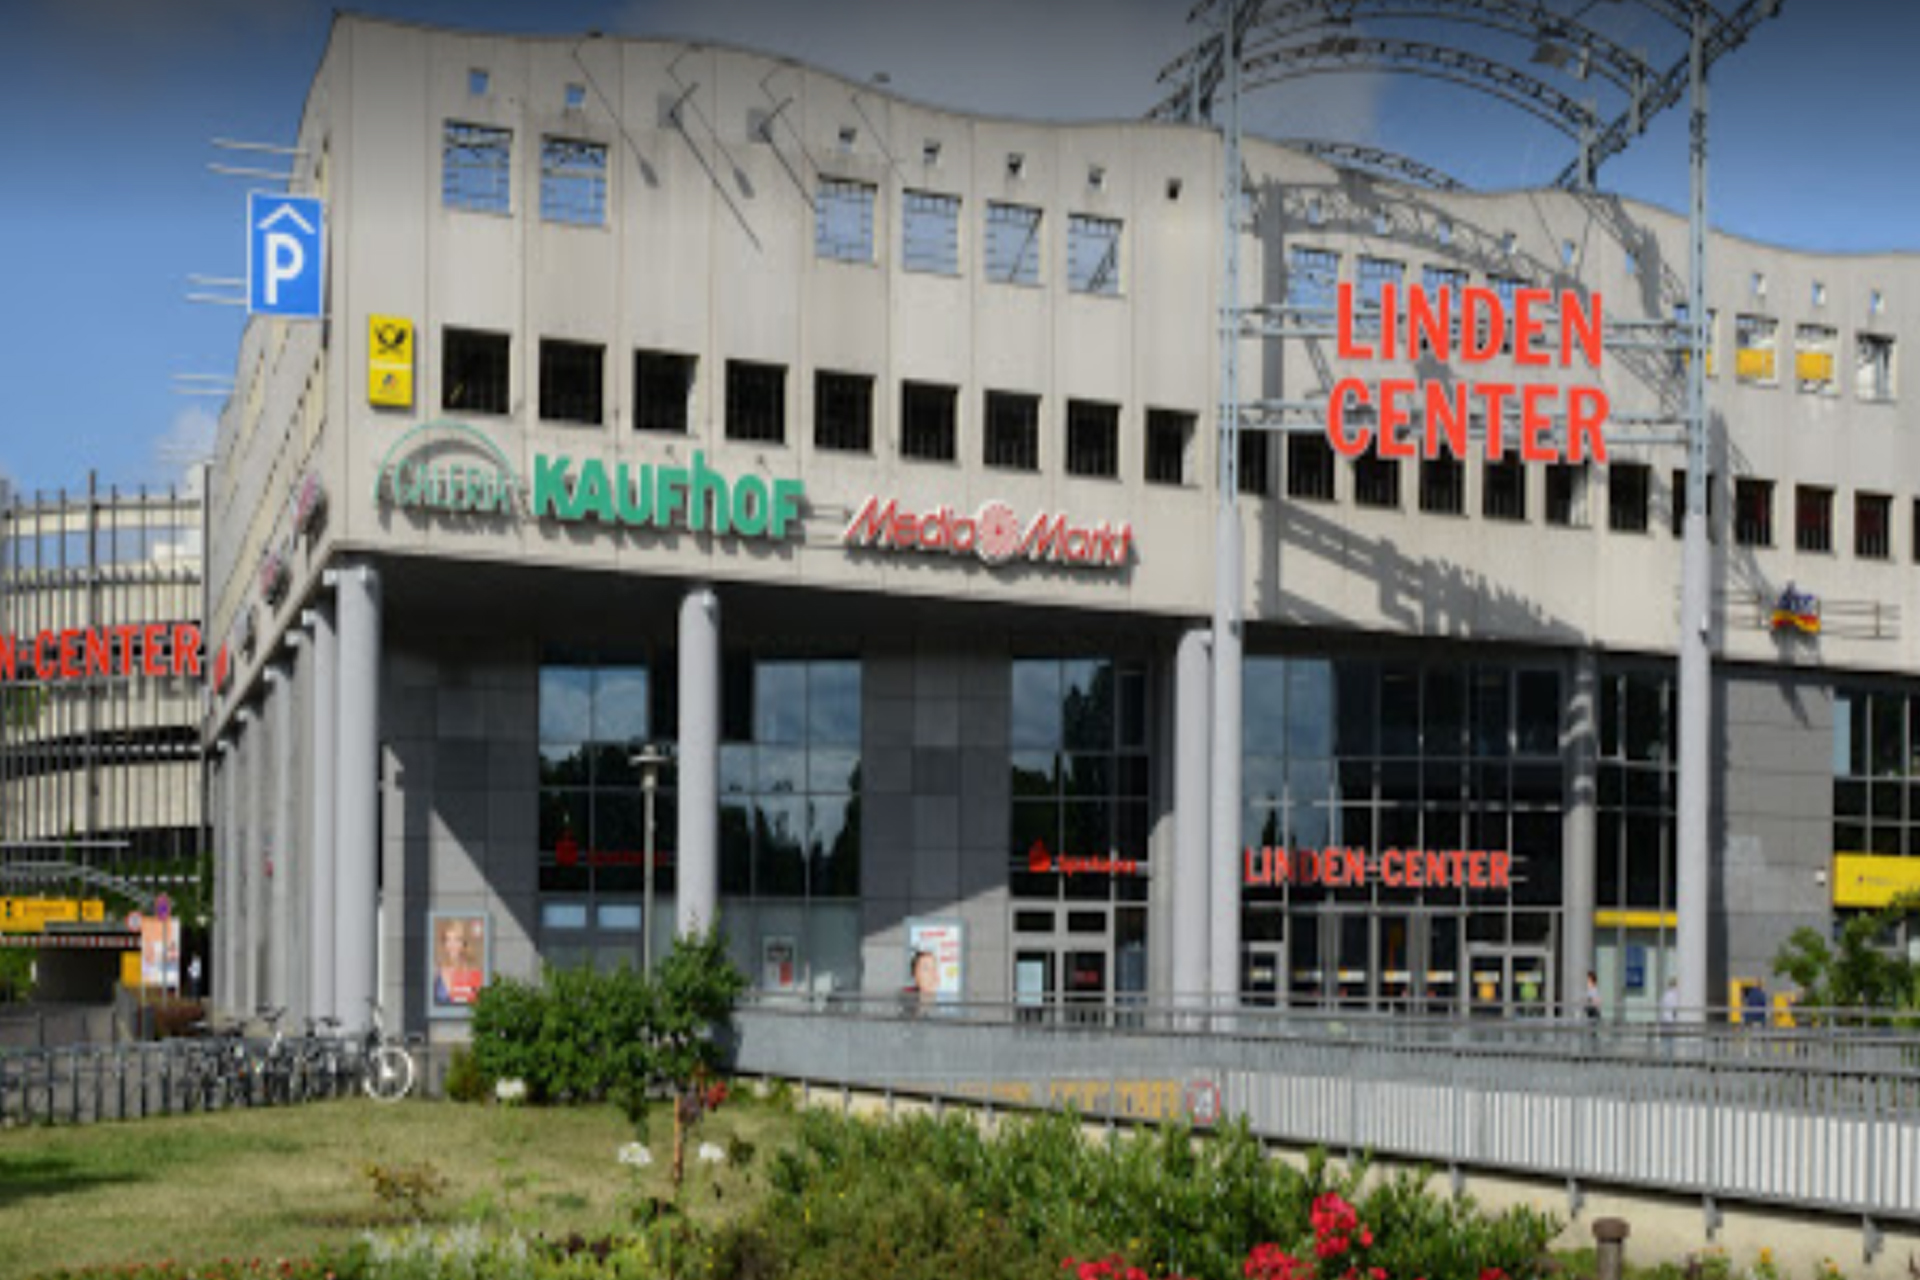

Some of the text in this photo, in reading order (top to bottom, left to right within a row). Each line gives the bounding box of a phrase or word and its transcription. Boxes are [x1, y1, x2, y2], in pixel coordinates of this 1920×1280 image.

[265, 232, 305, 305] P
[1336, 282, 1603, 368] LINDEN
[1326, 376, 1611, 465] CENTER
[845, 494, 1133, 564] Media Markt
